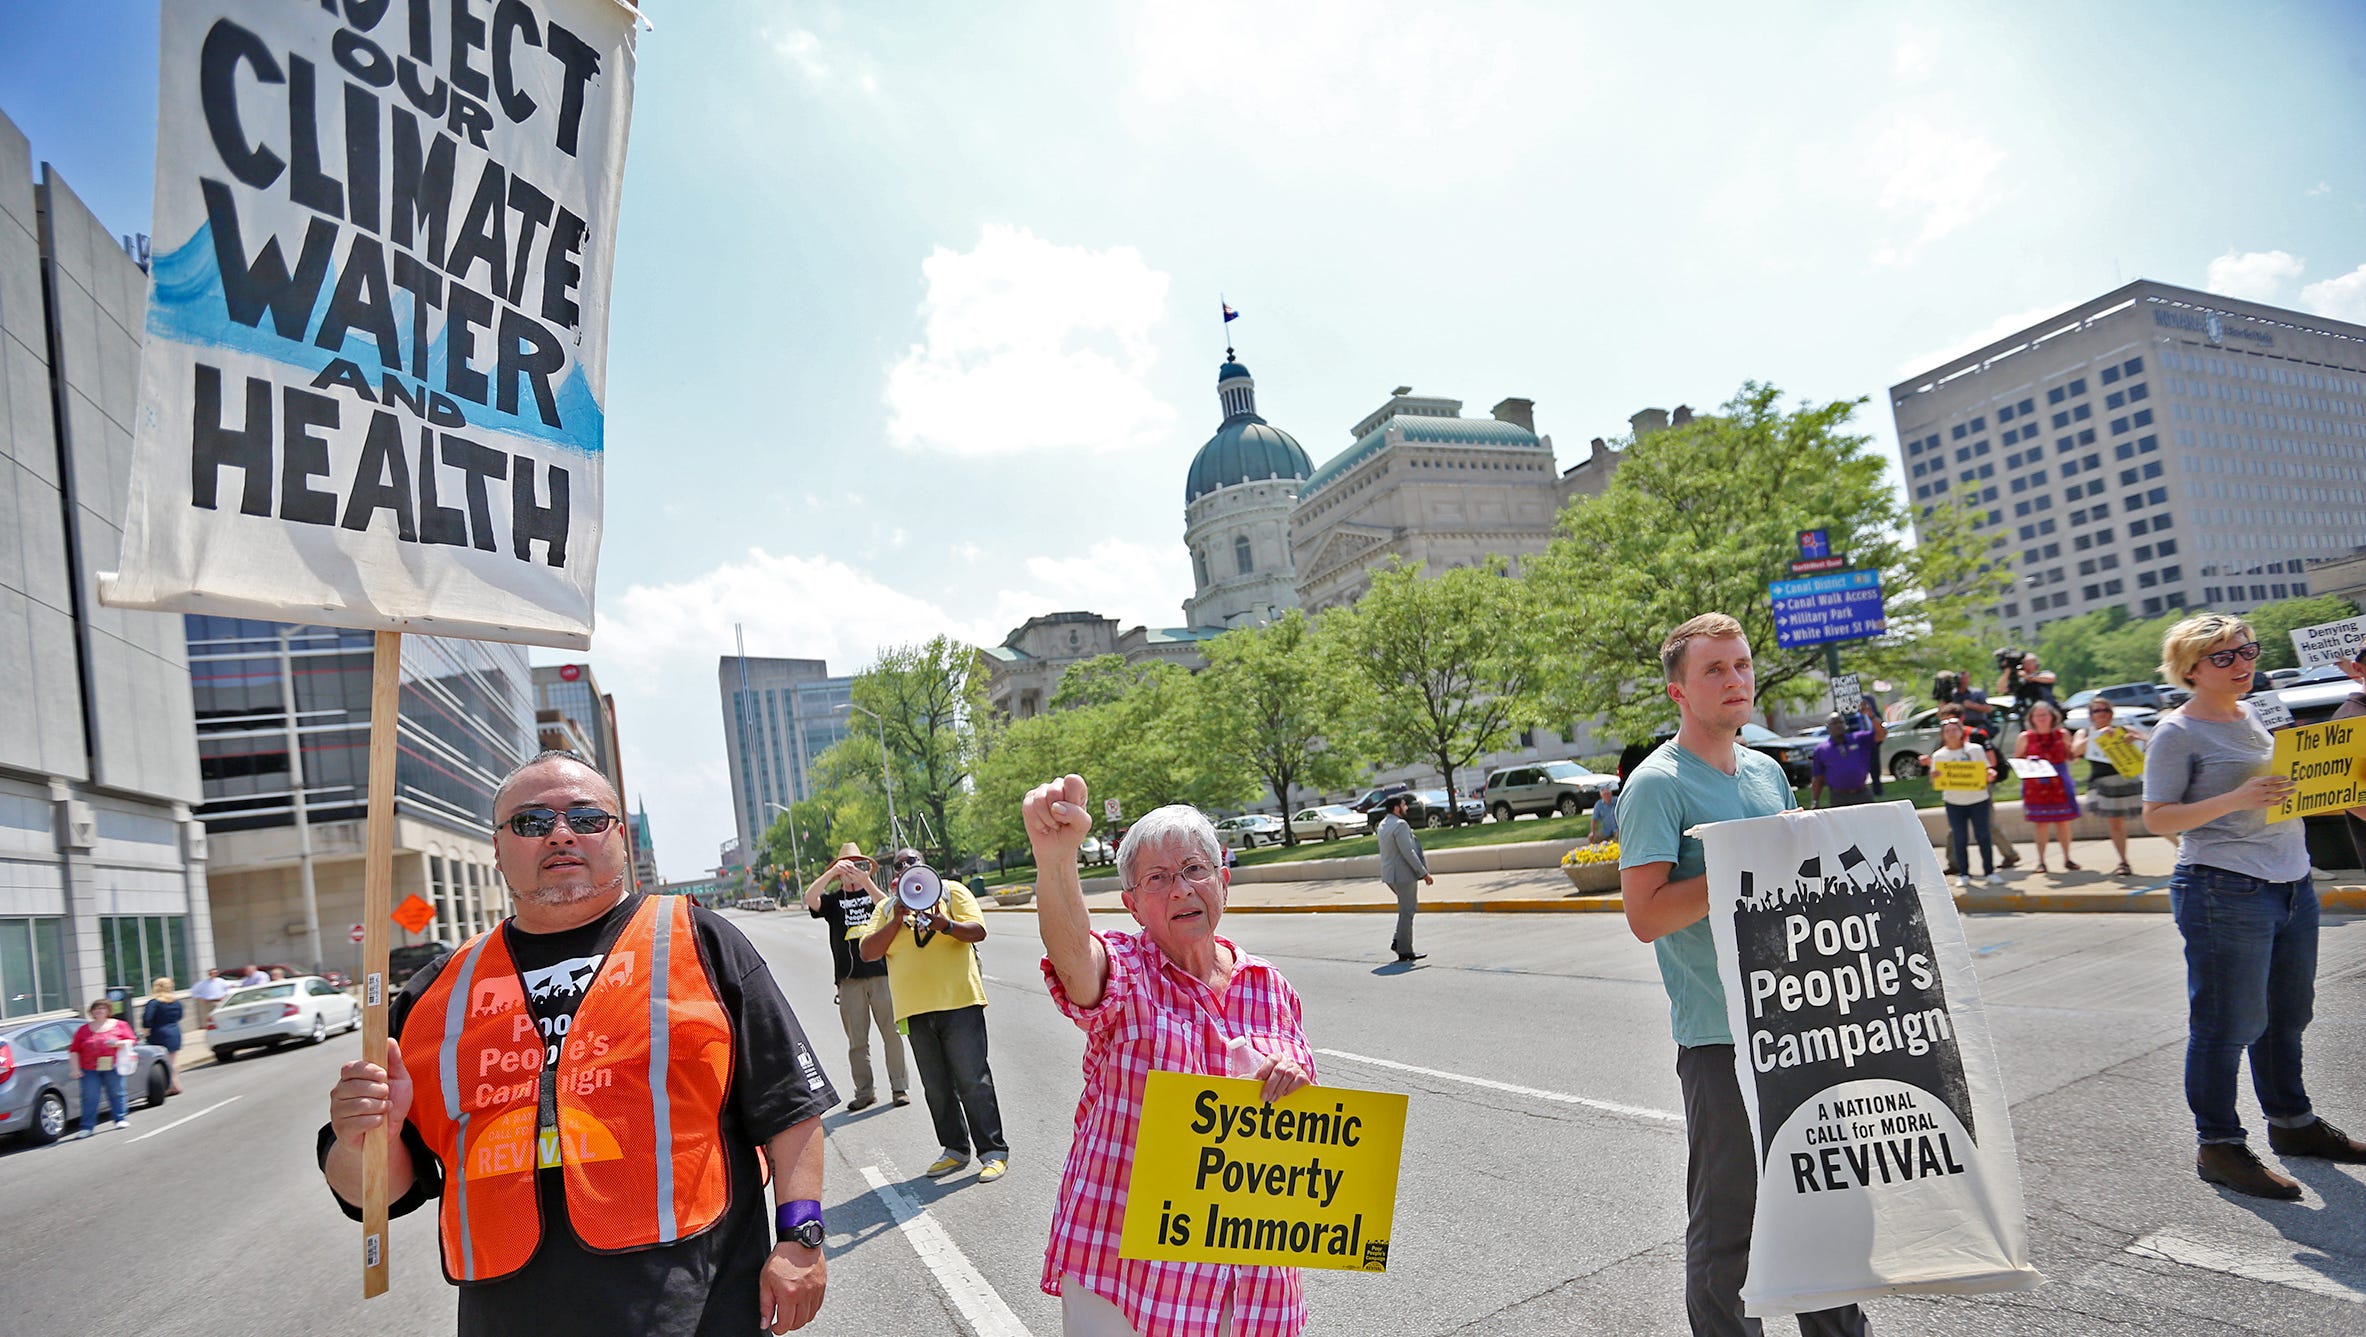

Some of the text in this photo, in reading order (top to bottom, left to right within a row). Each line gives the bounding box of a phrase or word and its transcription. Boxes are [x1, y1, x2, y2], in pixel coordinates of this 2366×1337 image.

[332, 27, 494, 151] OUR
[199, 17, 591, 334] CLIMATE
[198, 176, 566, 430] WATER
[310, 358, 467, 430] AND
[192, 362, 570, 569] HEALTH
[1785, 577, 1846, 594] Canal District
[1787, 589, 1878, 610] Canal Walk Access
[1790, 607, 1853, 626] Military Park
[1792, 627, 1821, 641] White
[1824, 623, 1849, 637] River
[1852, 621, 1863, 633] St
[2308, 622, 2359, 638] Denying
[2301, 632, 2366, 652] Health Car
[2308, 653, 2319, 662] is
[2296, 724, 2353, 752] The War
[2291, 757, 2353, 782] Economy
[2281, 798, 2292, 815] is
[2296, 781, 2357, 812] Immoral
[1785, 911, 1881, 963] Poor
[1749, 945, 1934, 1019] People's
[1751, 1005, 1951, 1074] Campaign
[475, 1066, 613, 1109] Camign
[1818, 1090, 1916, 1121] A NATIONAL
[1190, 1089, 1363, 1147] Systemic
[1806, 1111, 1939, 1146] CALL for MORAL
[1195, 1146, 1344, 1208] Poverty
[1790, 1132, 1965, 1194] REVIVAL
[1157, 1200, 1363, 1256] is Immoral
